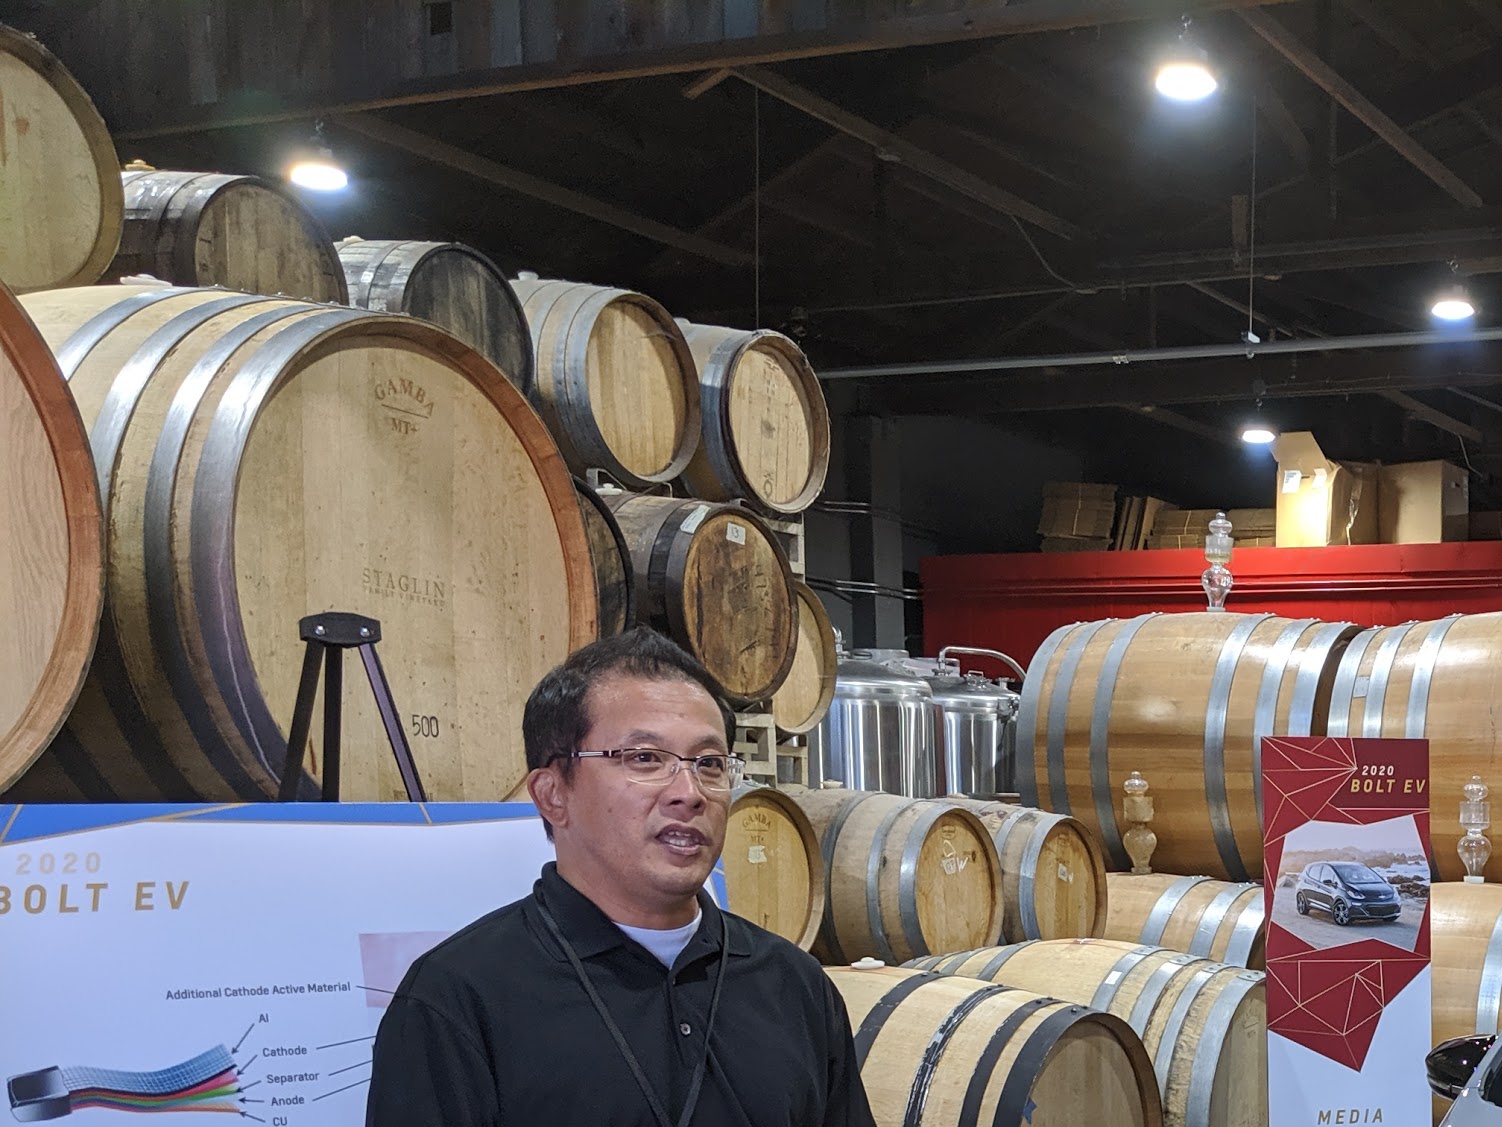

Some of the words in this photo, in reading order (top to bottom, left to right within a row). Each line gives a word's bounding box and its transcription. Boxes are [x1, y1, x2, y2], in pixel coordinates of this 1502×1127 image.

[373, 377, 434, 416] GAMBA
[362, 567, 445, 599] STAGLIN
[411, 714, 440, 738] 500
[1361, 765, 1395, 776] 2020
[1350, 778, 1396, 793] BOLT
[1403, 779, 1427, 794] EV
[15, 852, 102, 875] 2020
[134, 880, 190, 911] EV
[165, 987, 222, 1001] Additional
[224, 985, 270, 998] Cathode
[272, 982, 306, 995] Active
[307, 981, 352, 994] Material
[262, 1045, 308, 1058] Cathode
[266, 1072, 320, 1085] Separator
[271, 1095, 305, 1107] Anode
[272, 1116, 288, 1127] CU
[1317, 1108, 1384, 1126] MEDIA
